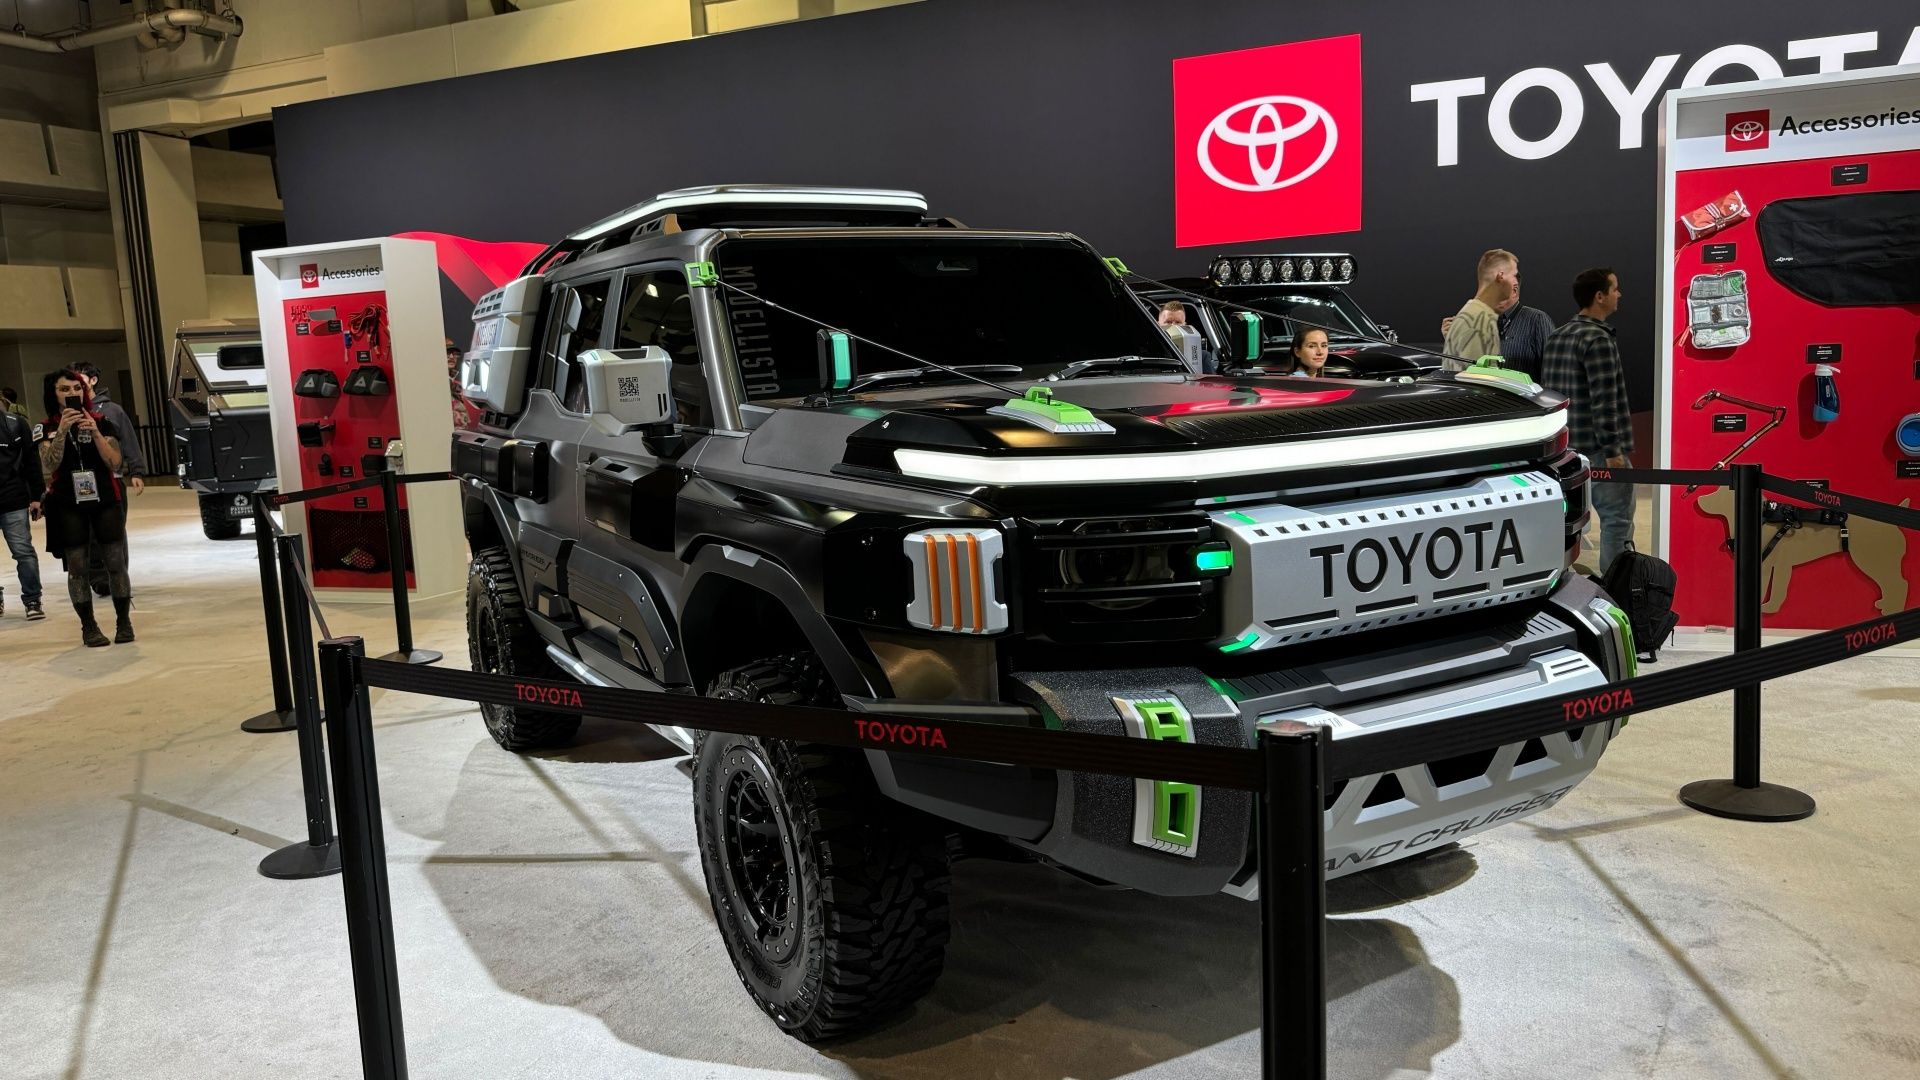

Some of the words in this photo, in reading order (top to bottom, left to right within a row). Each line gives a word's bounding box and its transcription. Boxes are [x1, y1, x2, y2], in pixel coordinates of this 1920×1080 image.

[1410, 26, 1920, 166] TOYT
[1778, 107, 1920, 137] Accessories
[322, 264, 380, 281] Accessories
[722, 265, 781, 395] MODELLISTA
[1589, 470, 1612, 480] OTA
[1814, 490, 1841, 507] TOYOTA
[1309, 518, 1524, 599] TOYOTA
[1844, 622, 1897, 652] TOYOTA
[514, 683, 583, 708] TOYOTA
[1562, 688, 1634, 721] TOYOTA
[854, 719, 948, 749] TOYOTA
[1323, 839, 1405, 872] AND
[1404, 783, 1575, 849] CRUISER
